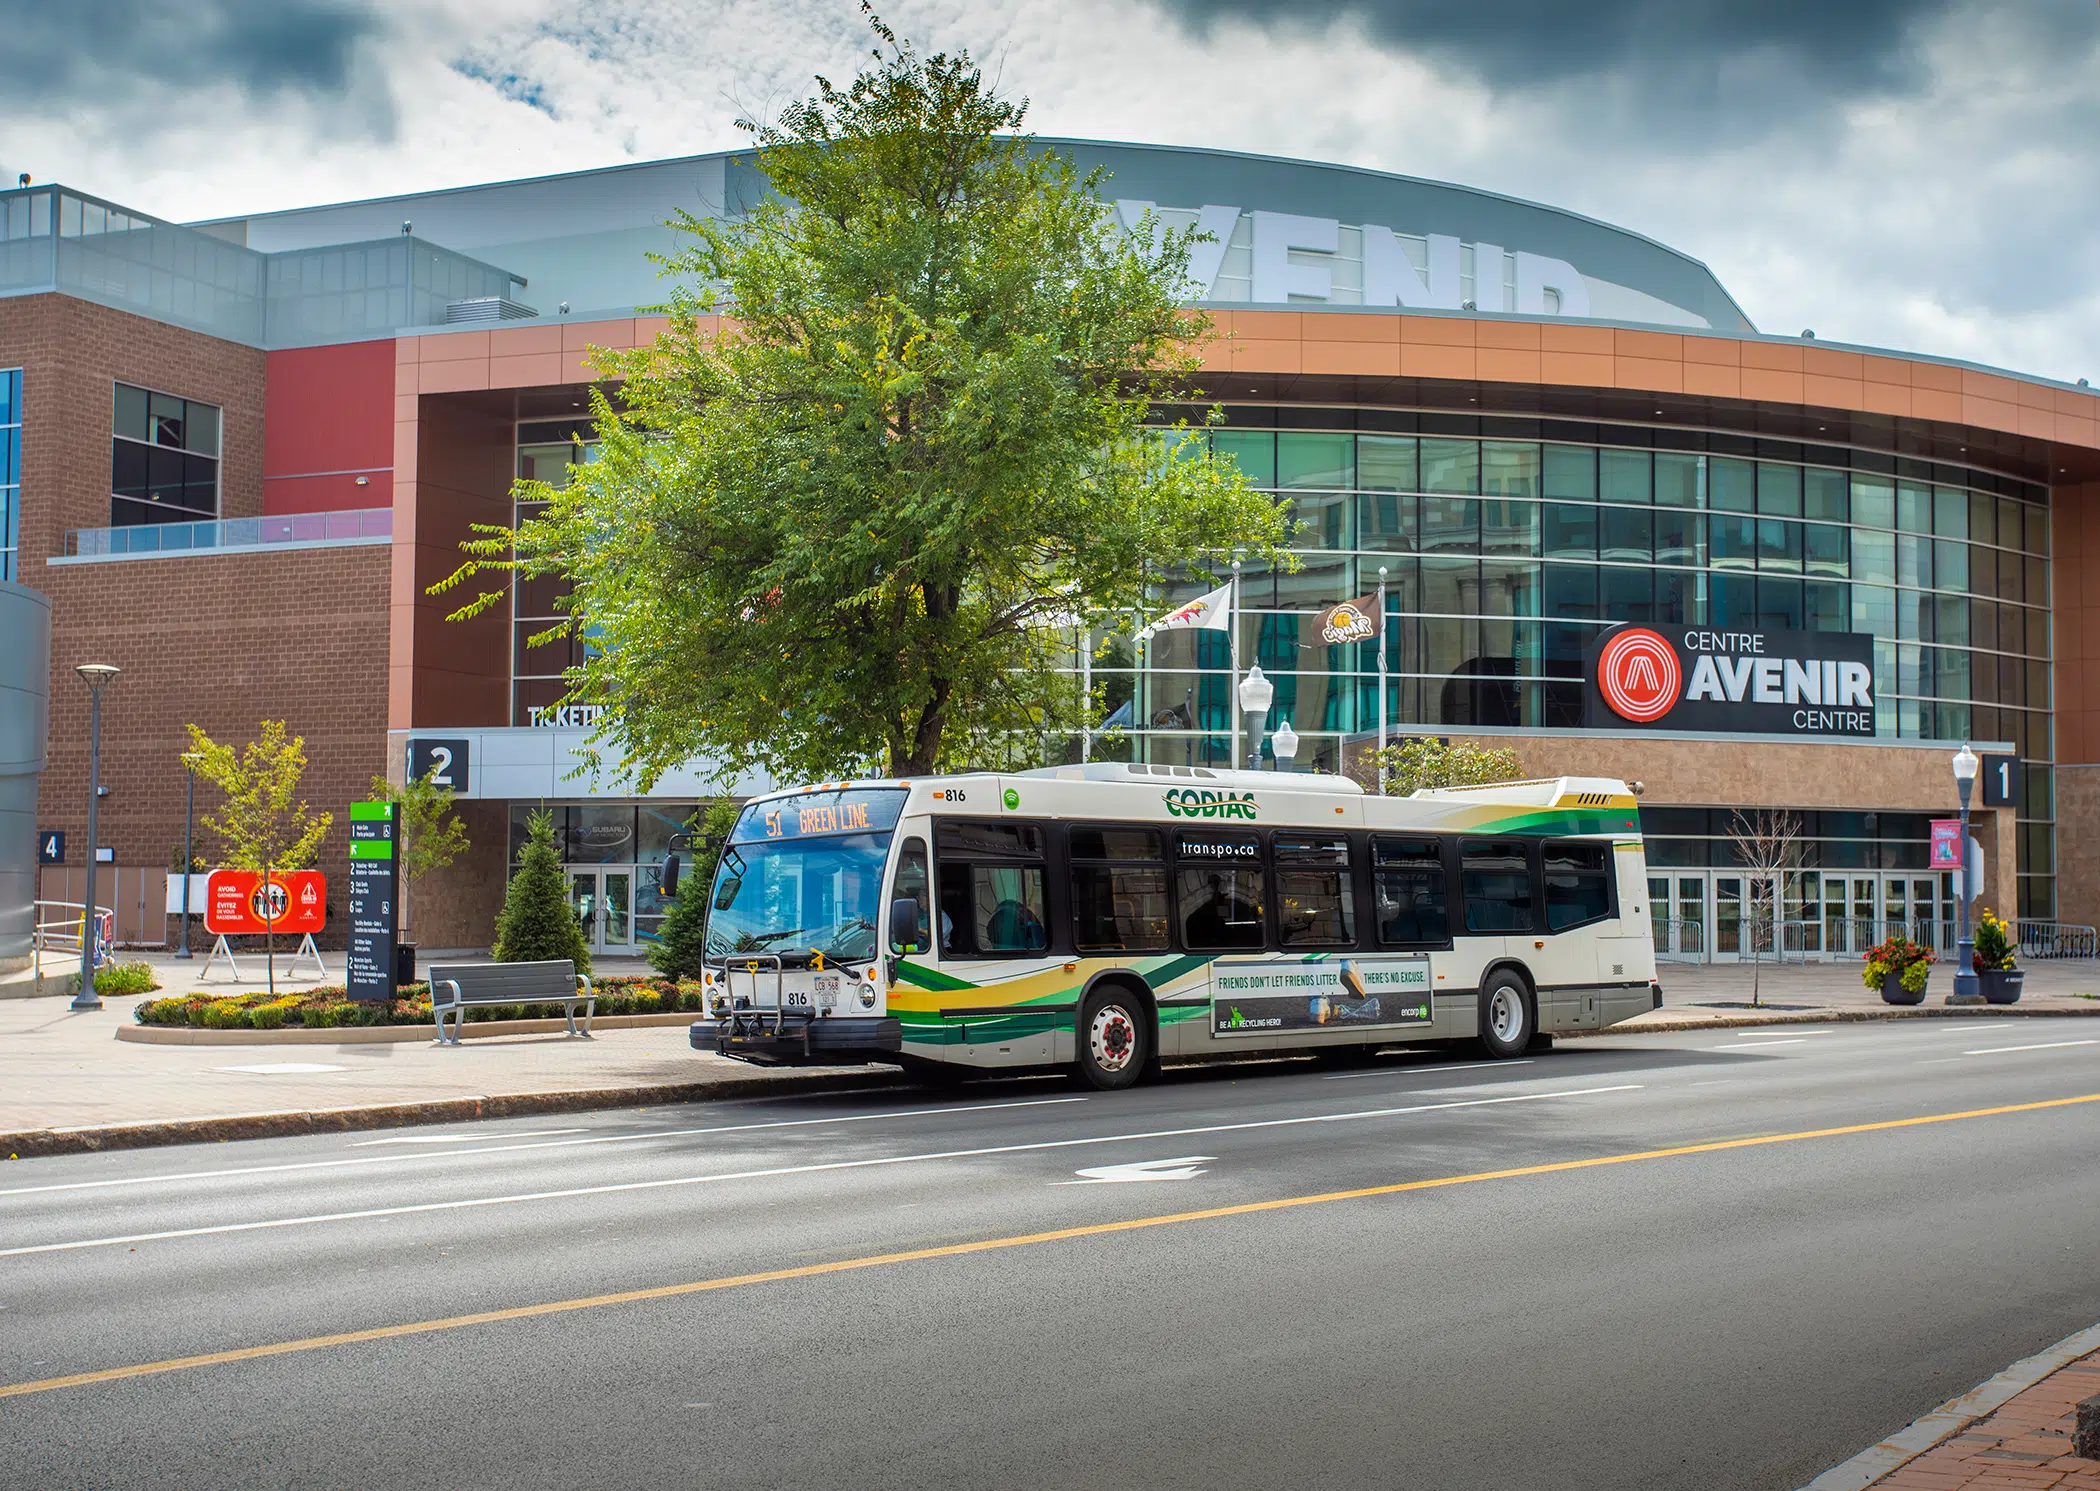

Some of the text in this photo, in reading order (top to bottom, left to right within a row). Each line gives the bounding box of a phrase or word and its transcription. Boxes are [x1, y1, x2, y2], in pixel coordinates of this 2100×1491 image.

[1116, 199, 1591, 317] VENIR
[1684, 631, 1764, 653] CENTRE
[1685, 655, 1874, 707] AVENIR
[1793, 710, 1871, 731] CENTRE
[430, 746, 453, 785] 2
[1998, 762, 2009, 799] 1
[945, 789, 966, 802] 816
[1165, 788, 1257, 820] CODIAC
[765, 802, 871, 838] 51 GREEN LINE
[352, 825, 355, 837] 1
[45, 835, 58, 858] 4
[1182, 841, 1255, 858] transpo.ca
[350, 863, 355, 875] 2
[350, 881, 355, 894] 3
[349, 900, 354, 913] 6
[348, 957, 353, 969] 2
[1218, 974, 1339, 989] FRIENDS DON'T LET FRIENDS LITTER.
[1364, 971, 1425, 984] THERE'S NO EXCUSE.
[788, 992, 807, 1005] 816
[1401, 1008, 1419, 1018] encorp
[1219, 1021, 1227, 1029] BE
[1238, 1019, 1266, 1028] RECYCLING
[1266, 1018, 1281, 1027] HERO!
